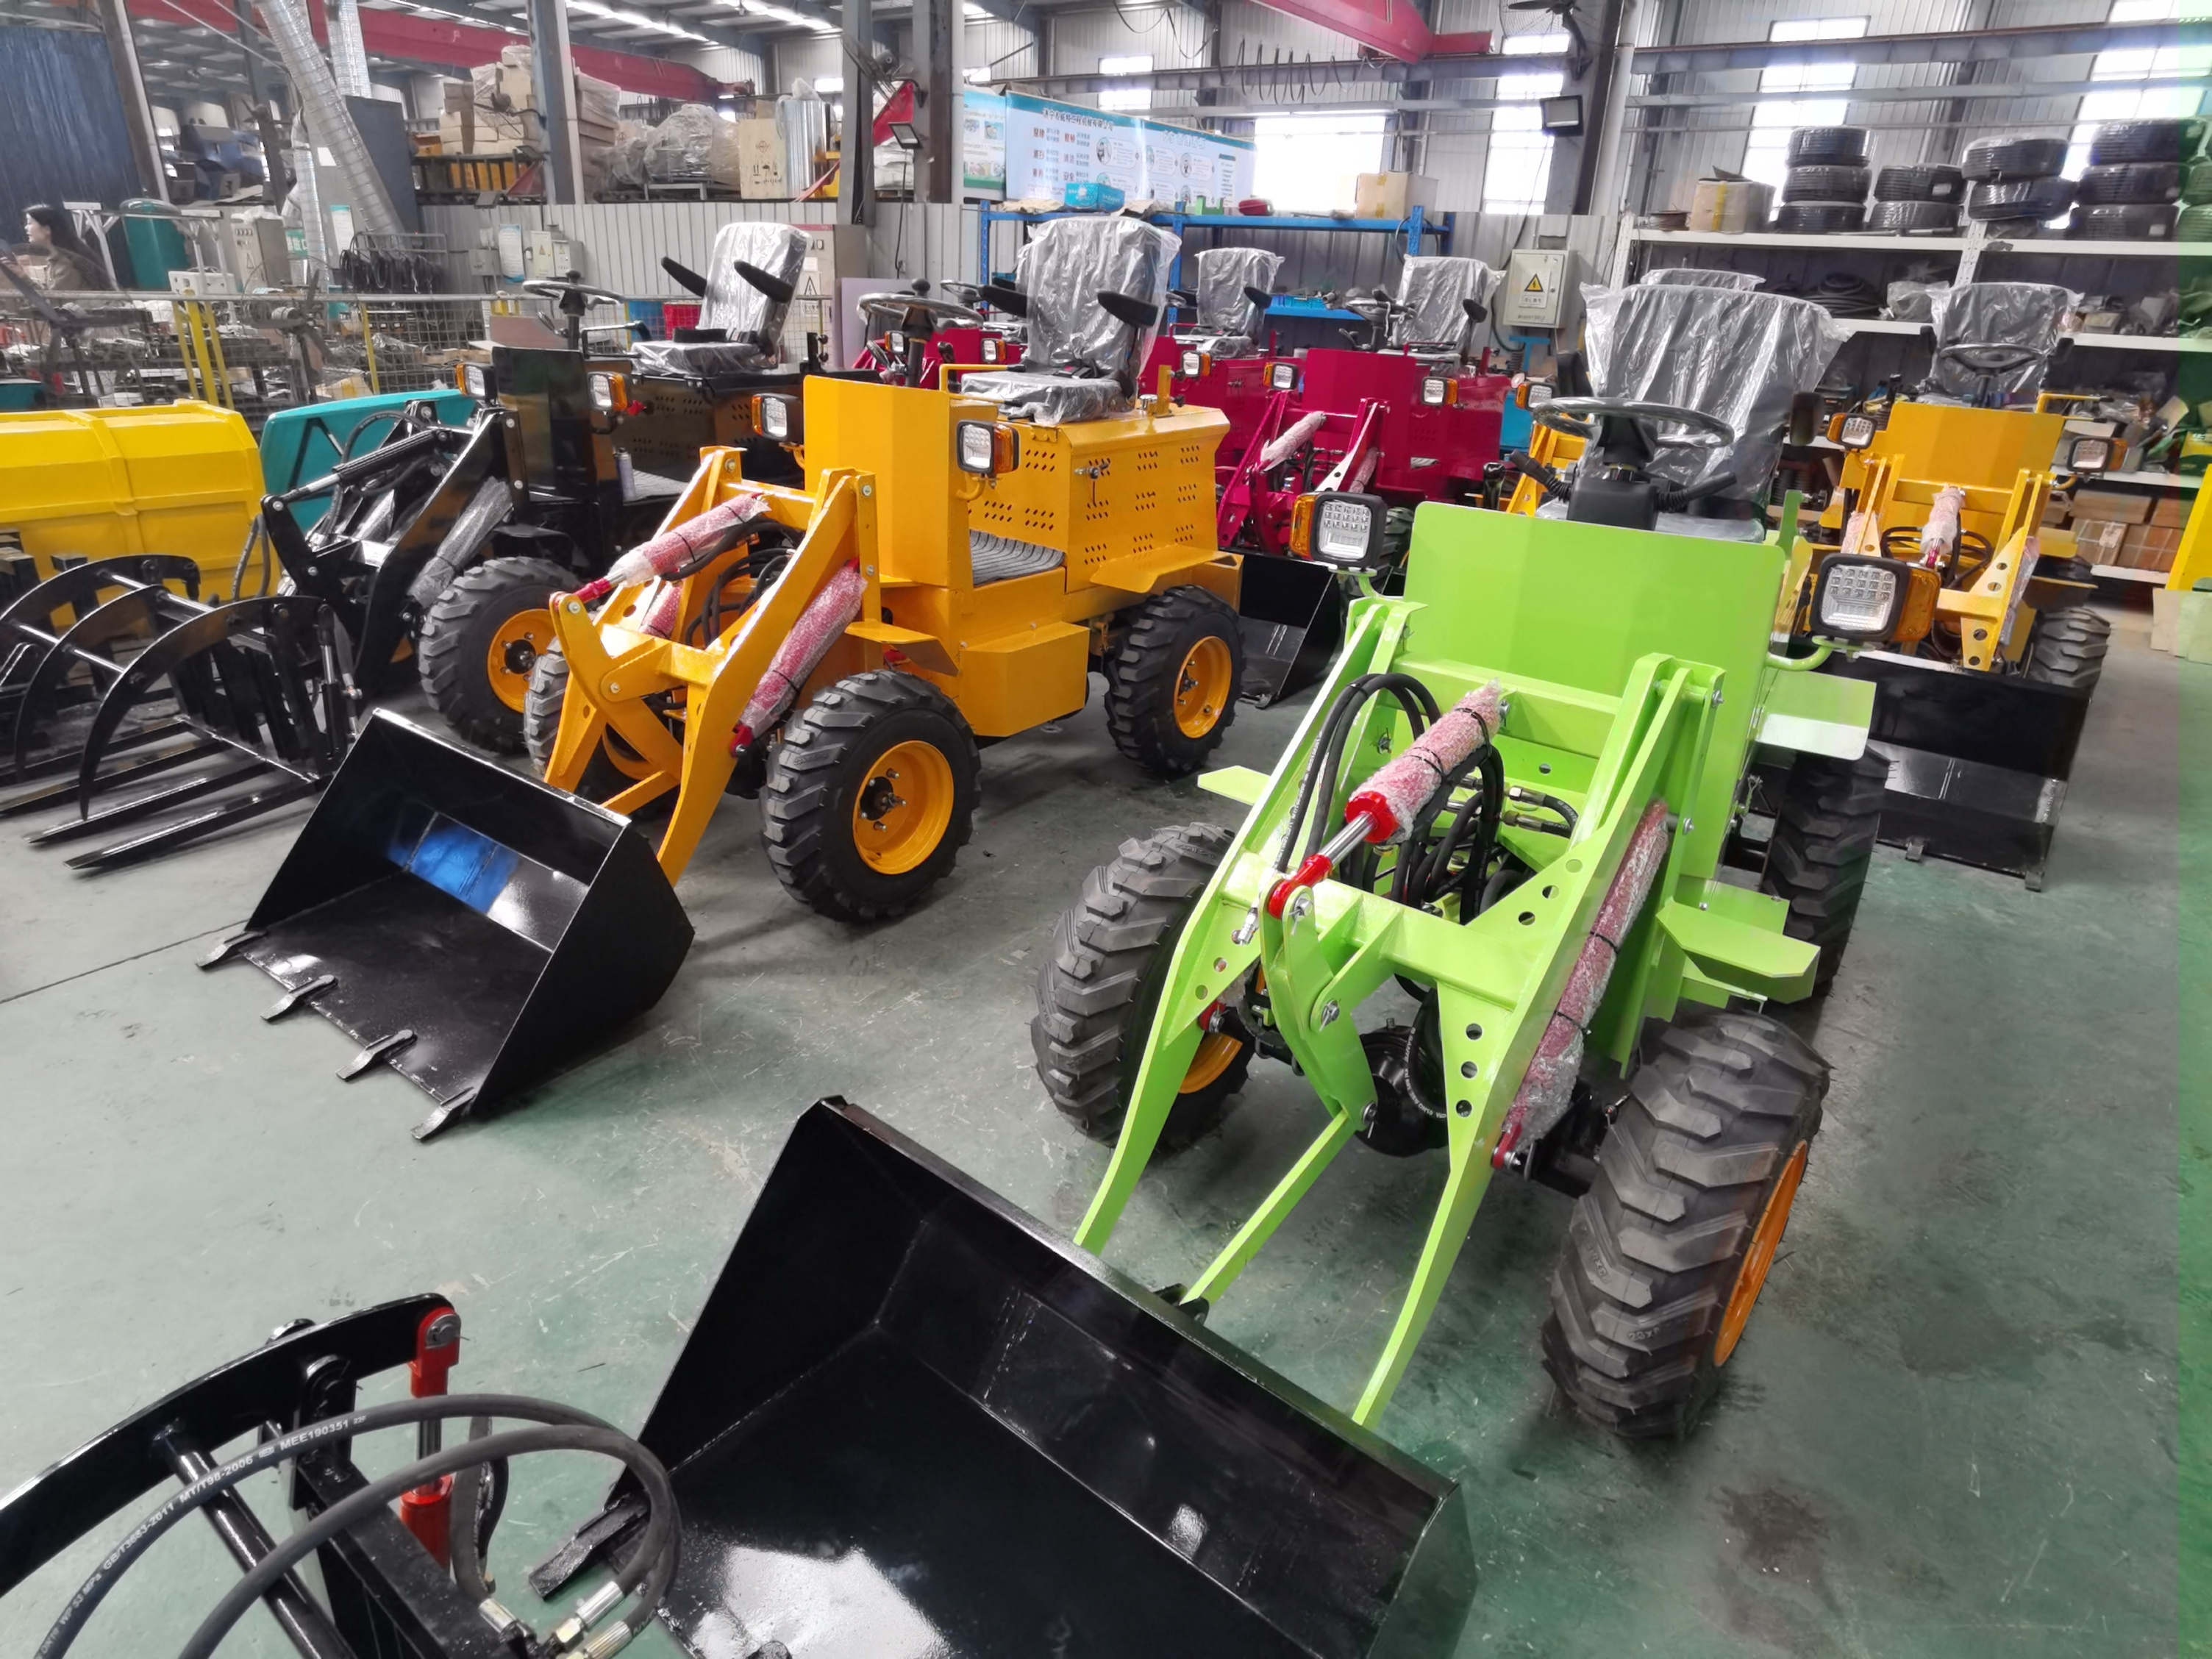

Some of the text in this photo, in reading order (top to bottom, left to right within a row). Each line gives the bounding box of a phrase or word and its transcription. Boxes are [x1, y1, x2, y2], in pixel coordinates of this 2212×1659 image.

[103, 1502, 174, 1570] GB/T3683-2011
[179, 1455, 253, 1503] MT/T98-2006
[280, 1419, 349, 1450] MEE190351
